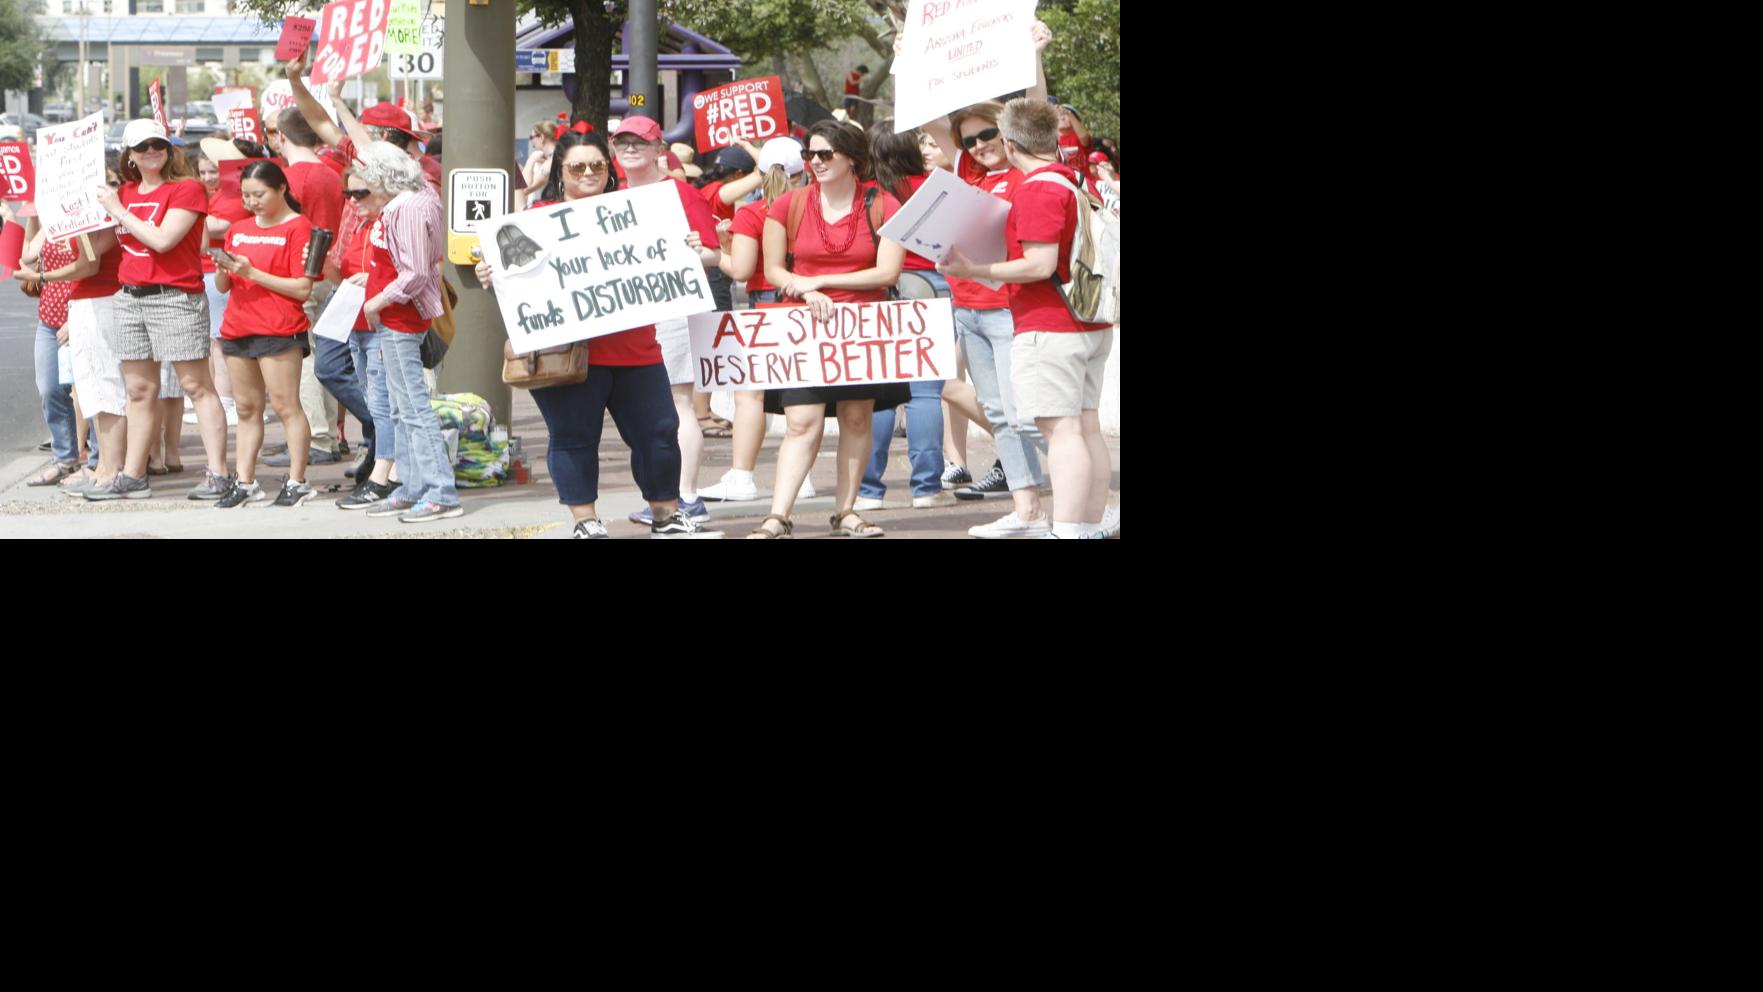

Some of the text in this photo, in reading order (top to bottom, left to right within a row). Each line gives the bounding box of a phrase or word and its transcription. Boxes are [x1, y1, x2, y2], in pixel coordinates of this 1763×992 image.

[328, 0, 385, 41] RED
[921, 0, 951, 25] RED
[316, 44, 346, 81] FOR
[346, 31, 384, 77] ED
[398, 53, 435, 74] 30
[948, 40, 983, 60] UNITED
[704, 93, 719, 103] WE
[720, 81, 769, 99] SUPPORT
[707, 93, 772, 124] #RED
[708, 116, 776, 147] forED
[549, 200, 638, 241] I find
[600, 244, 640, 270] lack
[646, 238, 667, 261] of
[517, 267, 704, 334] funds DISTURBING
[712, 301, 928, 349] AZ STUDENTS
[699, 337, 940, 387] DESERVE BETTER
